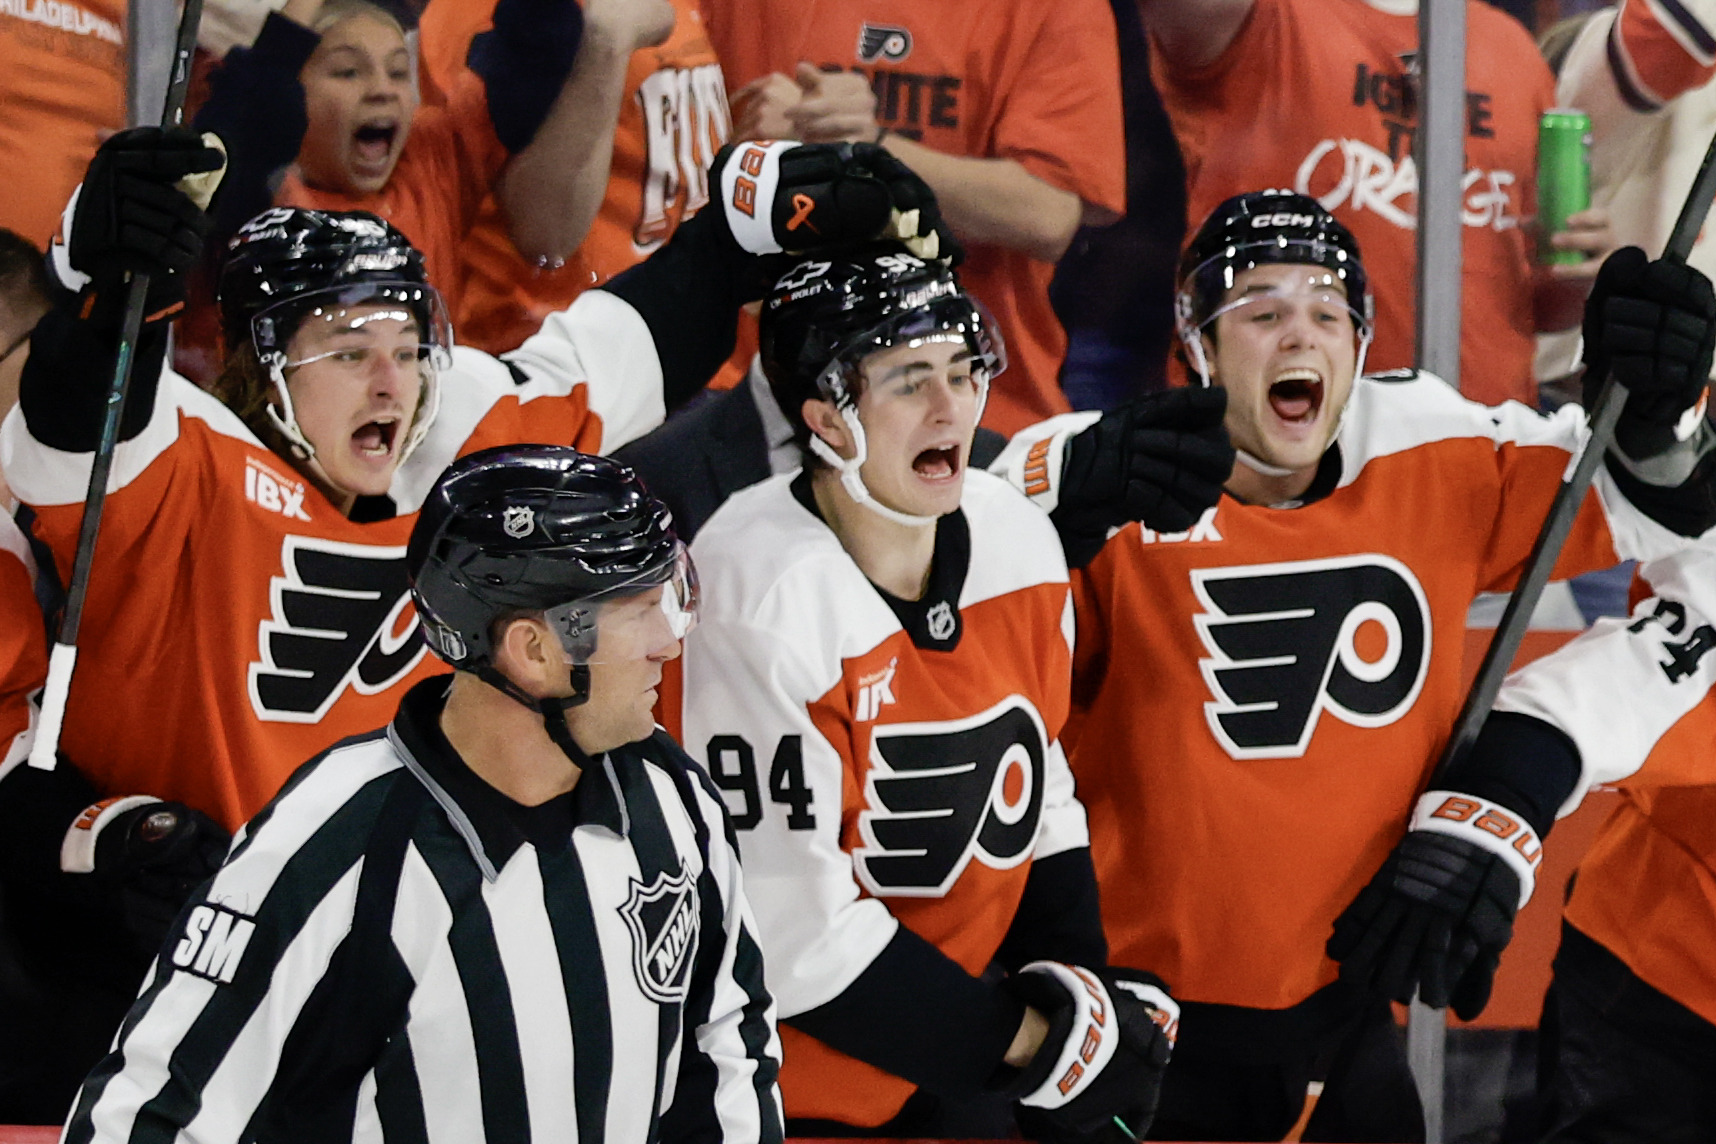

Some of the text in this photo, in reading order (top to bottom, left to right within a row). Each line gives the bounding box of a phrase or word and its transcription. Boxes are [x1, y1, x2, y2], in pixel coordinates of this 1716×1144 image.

[1251, 213, 1315, 229] CCM
[1294, 137, 1518, 232] ORAGE
[245, 465, 312, 523] IBX
[706, 734, 817, 831] 94
[172, 904, 257, 984] SM
[654, 900, 694, 983] NHL
